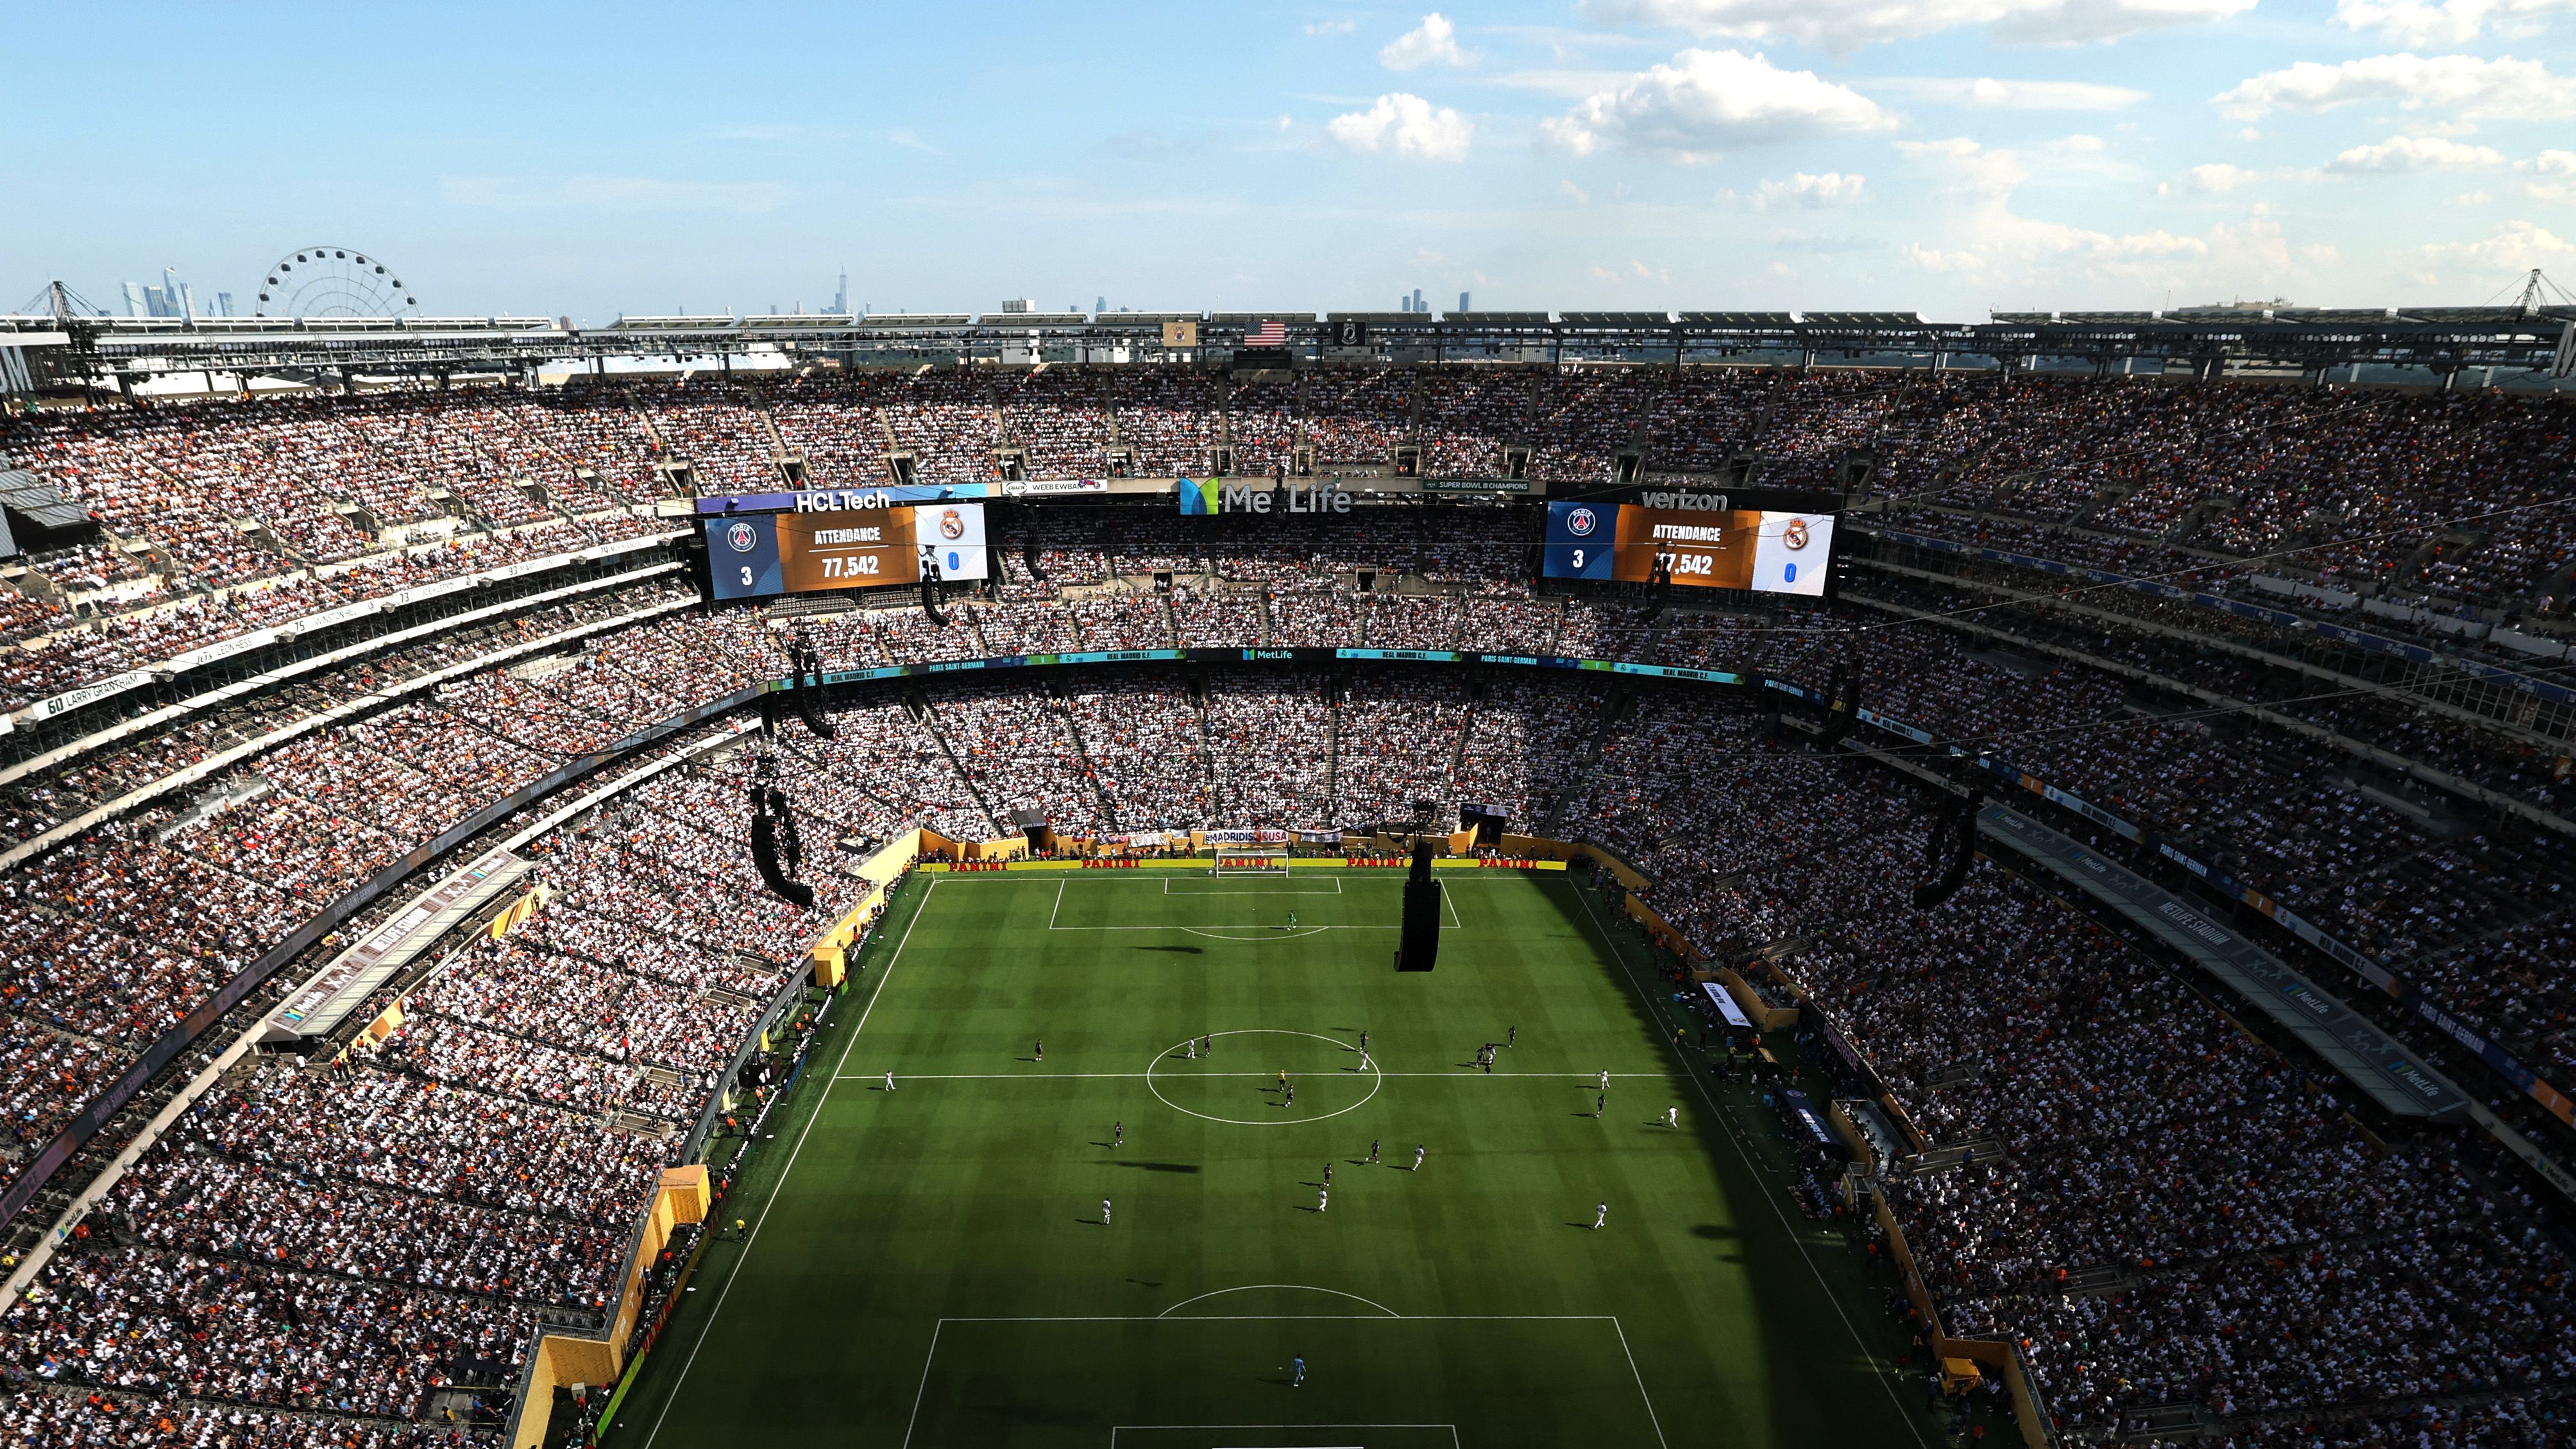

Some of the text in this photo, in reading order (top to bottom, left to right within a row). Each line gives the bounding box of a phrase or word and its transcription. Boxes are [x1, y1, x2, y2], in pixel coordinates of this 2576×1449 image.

[795, 490, 890, 513] HCLTech
[1224, 484, 1351, 513] MeLife
[1641, 488, 1727, 512] verizon
[731, 524, 750, 532] PARIS
[814, 527, 881, 545] ATTENDANCE
[1652, 525, 1721, 541] ATTENDANCE
[822, 555, 879, 579] 77,542
[948, 551, 959, 571] 0
[1573, 550, 1584, 568] 3
[740, 566, 753, 586] 3
[1784, 563, 1797, 582] 0
[399, 593, 410, 603] 73
[294, 620, 305, 632] 75
[216, 636, 253, 657] LEON HESS
[1257, 650, 1292, 659] MetLife
[196, 650, 213, 665] JETS
[945, 661, 985, 670] SAINT-GERMAIN
[1497, 656, 1538, 665] SAINT-GERMAIN
[831, 674, 843, 682] REAL
[844, 673, 865, 681] MADRID
[1677, 670, 1699, 679] MADRID
[1700, 672, 1709, 680] C.F.
[47, 673, 139, 716] 60 LARRY GRANTHAM
[2001, 815, 2025, 829] MetLife
[1205, 830, 1287, 842] #MADRIDIS USA
[949, 862, 1008, 872] PANINI
[1081, 859, 1140, 869] PANINI
[1347, 858, 1405, 868] PANINI
[1479, 859, 1538, 869] PANINI
[2081, 855, 2108, 873] MetLife
[2160, 843, 2208, 878] PARIS SAINT-GERMAIN
[2158, 901, 2232, 946] METLIFE STADIUM
[368, 926, 403, 952] METLIFE
[294, 991, 325, 1012] MetLife
[2296, 991, 2330, 1014] MetLife
[2418, 1001, 2487, 1055] PARIS SAINT-GERMAIN
[1823, 1022, 1859, 1074] POWERADE
[2402, 1069, 2439, 1097] MetLife
[65, 1206, 84, 1230] MetLife
